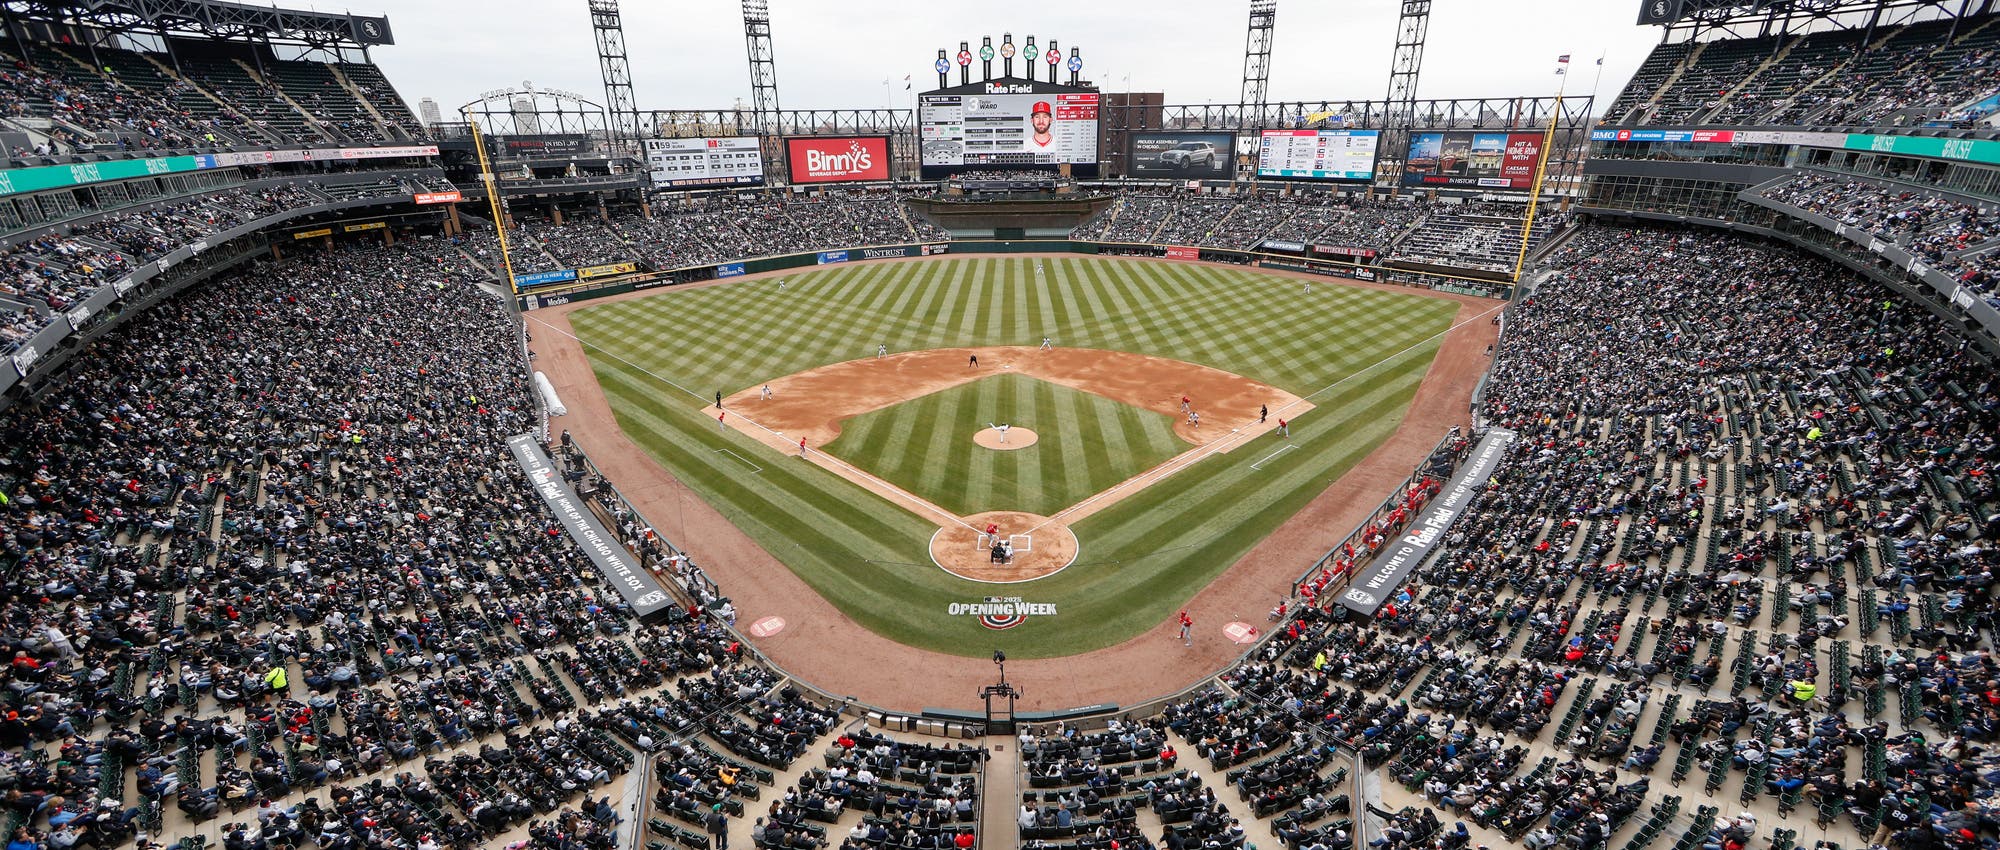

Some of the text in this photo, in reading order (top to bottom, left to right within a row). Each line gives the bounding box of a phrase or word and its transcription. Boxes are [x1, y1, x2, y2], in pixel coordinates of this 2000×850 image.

[986, 83, 1033, 94] Rate Field
[480, 87, 583, 105] KIDS ZONE
[968, 98, 978, 111] 3
[660, 141, 671, 149] 59
[1880, 136, 1896, 152] RUSH
[1950, 140, 1975, 160] RUSH
[1507, 147, 1524, 155] HOME
[80, 164, 102, 183] RUSH
[1498, 194, 1529, 202] LANDING
[864, 249, 906, 257] WINTRUST
[526, 274, 543, 282] RELIEF
[1356, 268, 1374, 278] Rate
[548, 297, 569, 306] Modelo
[1480, 446, 1497, 458] WHITE
[1468, 458, 1488, 477] CHICAGO
[530, 467, 551, 485] Rate
[1460, 476, 1476, 486] THE
[539, 482, 565, 500] Field
[1455, 485, 1467, 493] OF
[559, 498, 576, 514] HOME
[1442, 492, 1462, 507] HOME
[569, 512, 582, 520] OF
[1425, 508, 1455, 529] Field
[575, 519, 591, 532] THE
[584, 530, 612, 556] CHICAGO
[1403, 527, 1440, 548] Rate
[1401, 547, 1414, 557] TO
[606, 554, 632, 577] WHITE
[1366, 555, 1406, 589] WELCOME
[624, 576, 645, 592] SOX
[948, 602, 1057, 616] OPENING WEEK
[1892, 810, 1909, 822] 88
